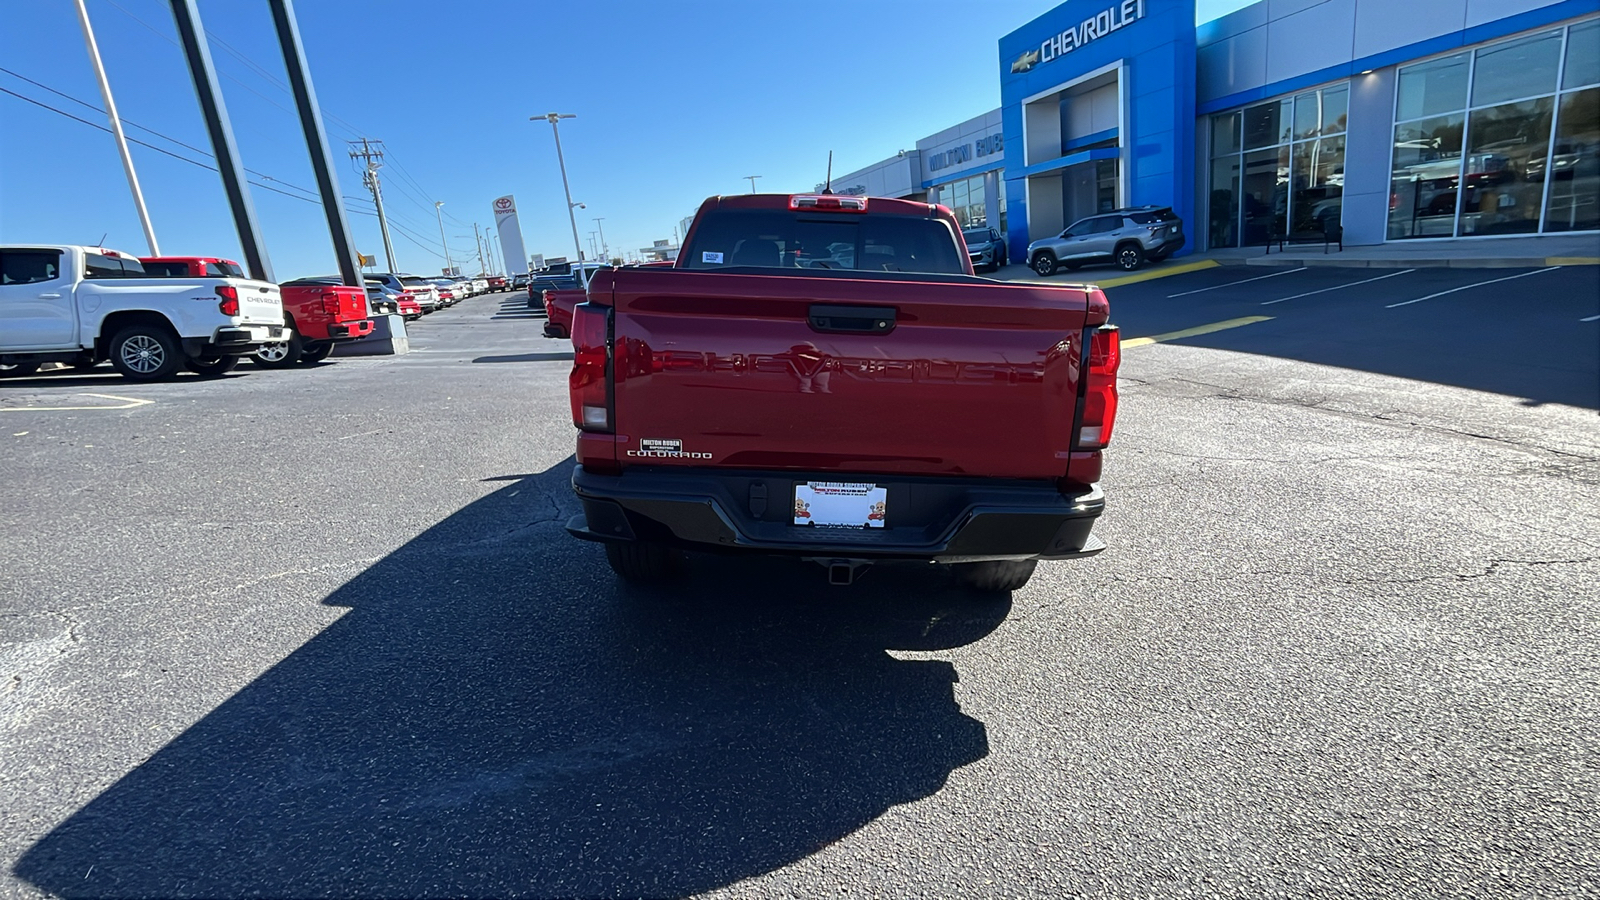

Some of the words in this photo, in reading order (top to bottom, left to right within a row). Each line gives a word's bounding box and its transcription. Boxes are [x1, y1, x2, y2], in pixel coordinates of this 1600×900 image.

[1041, 0, 1144, 62] CHEVROLET
[247, 296, 280, 305] CHEVROLET
[627, 450, 712, 459] COLORADO
